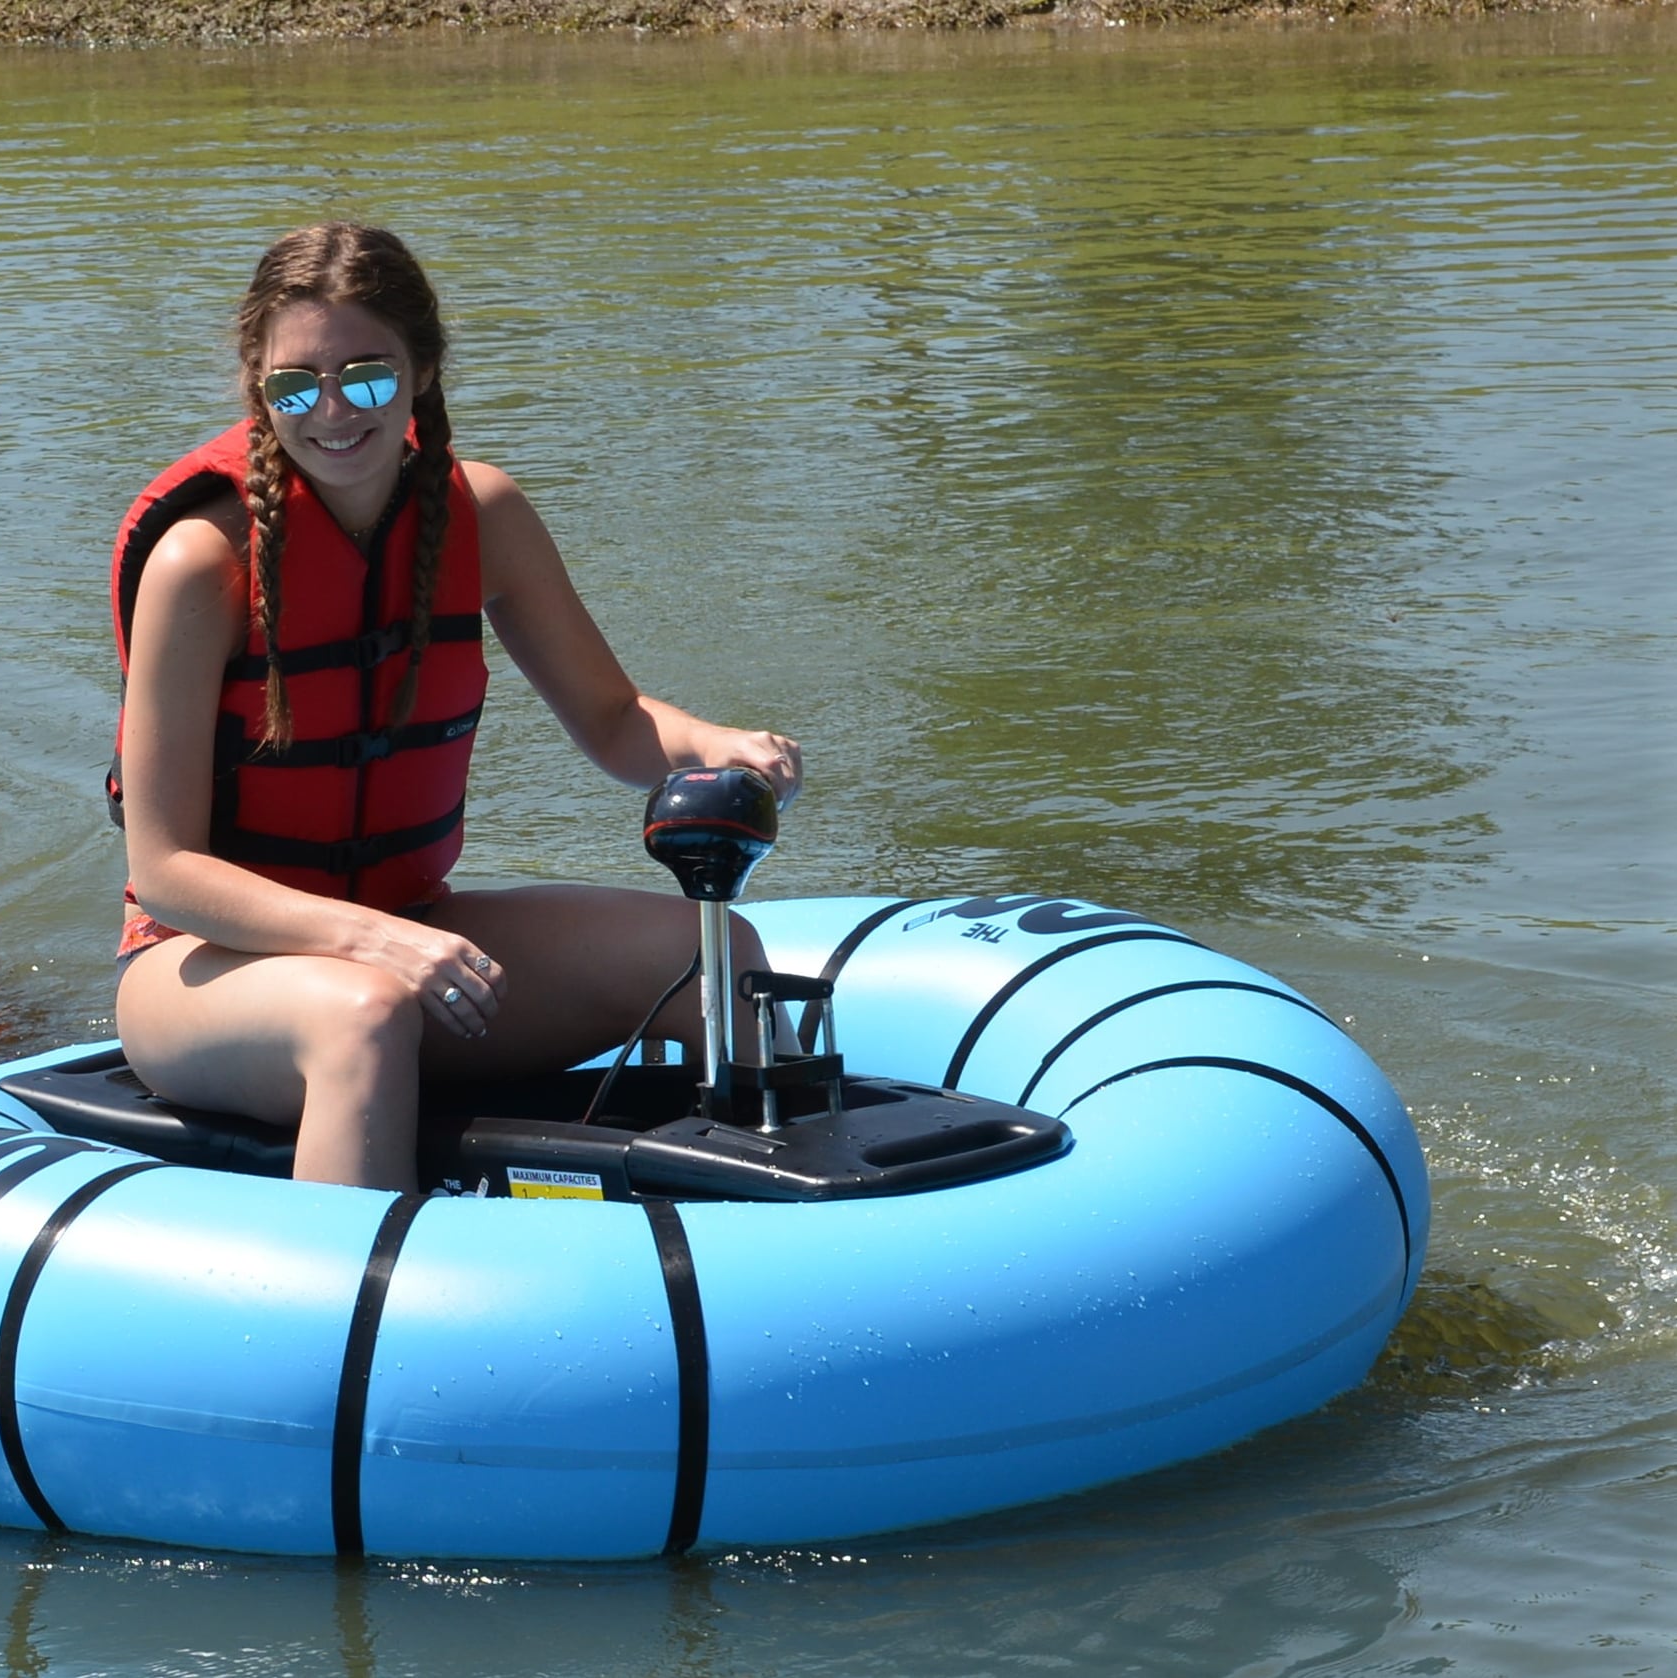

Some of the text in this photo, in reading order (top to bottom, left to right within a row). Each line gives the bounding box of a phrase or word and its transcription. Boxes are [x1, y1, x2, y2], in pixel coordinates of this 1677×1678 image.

[960, 922, 1010, 943] THE
[443, 1178, 462, 1190] THE
[513, 1170, 597, 1186] MAXIMUM CAPACITIES
